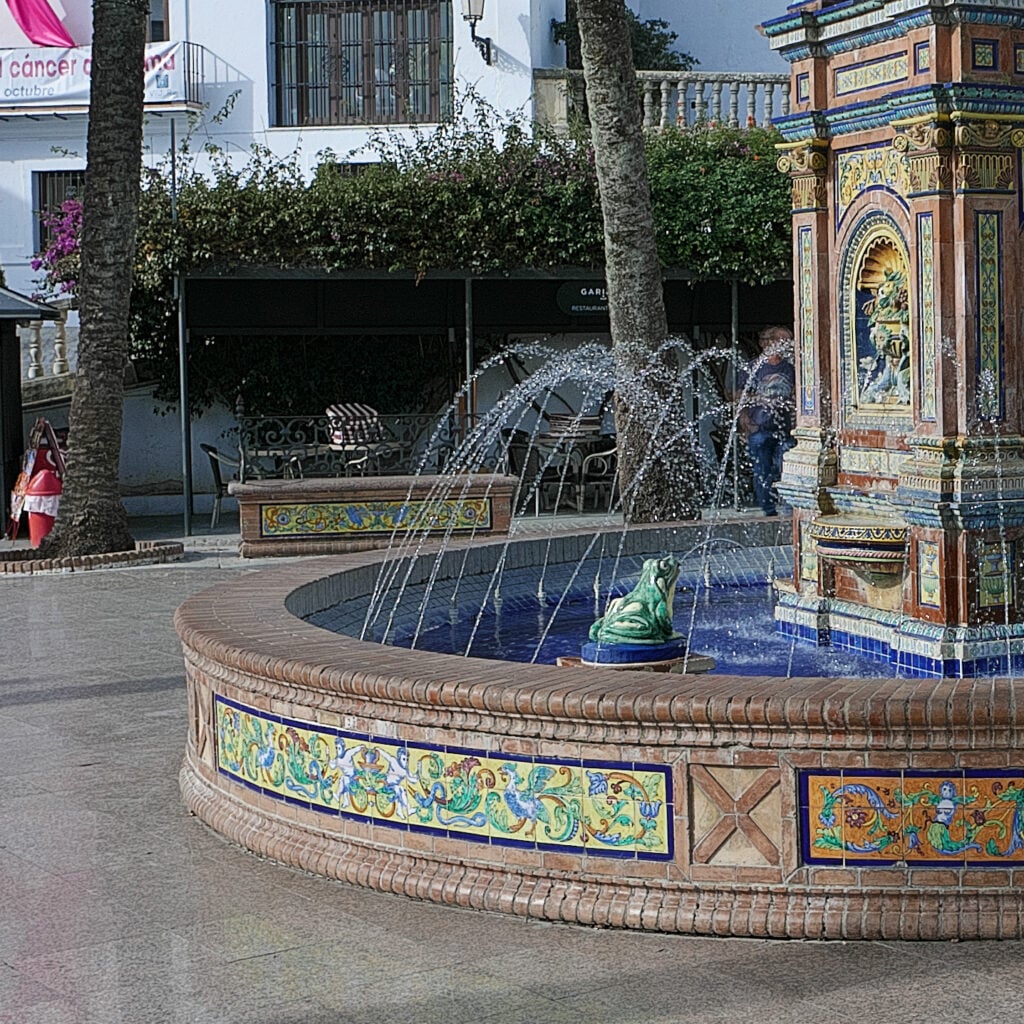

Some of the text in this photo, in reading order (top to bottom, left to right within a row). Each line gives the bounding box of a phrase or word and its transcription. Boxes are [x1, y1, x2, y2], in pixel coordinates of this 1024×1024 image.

[9, 53, 77, 78] cáncer
[4, 85, 55, 97] octubre
[580, 287, 609, 298] GARI
